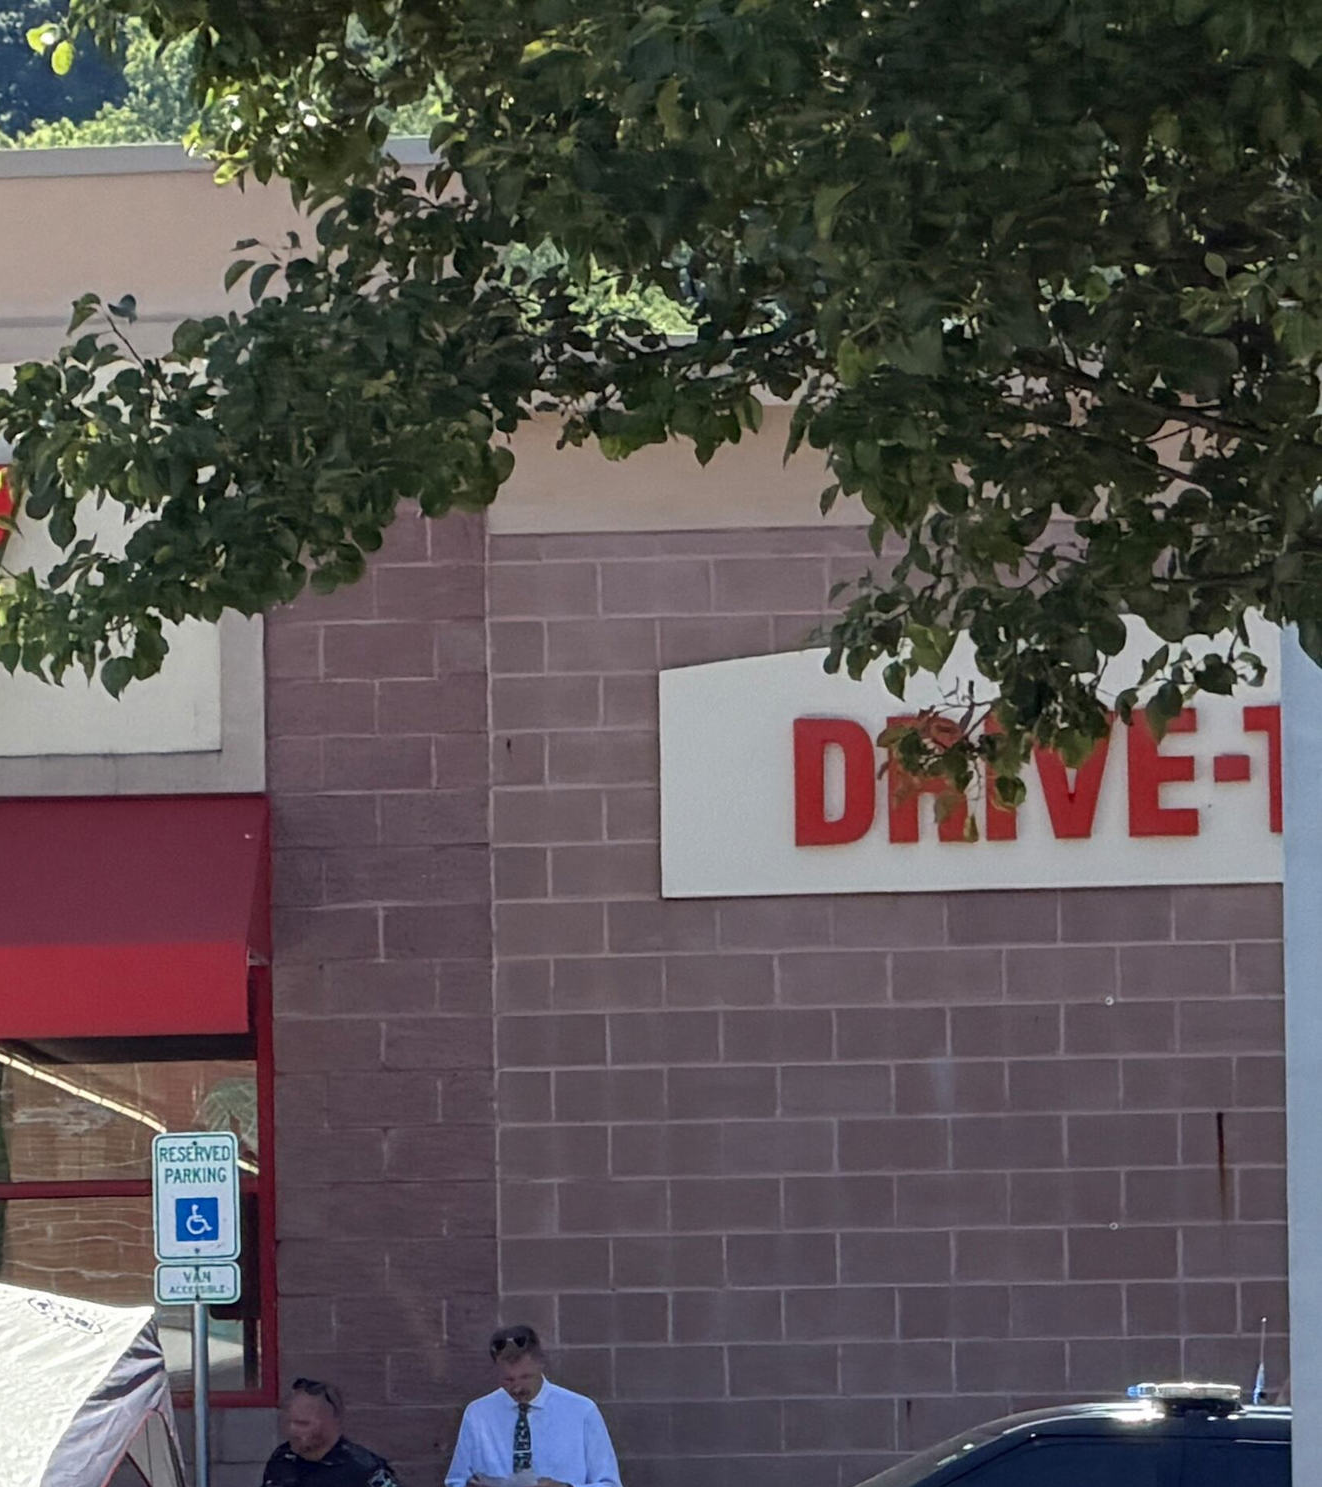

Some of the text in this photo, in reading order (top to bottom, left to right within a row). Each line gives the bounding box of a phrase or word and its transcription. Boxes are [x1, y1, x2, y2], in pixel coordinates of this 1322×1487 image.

[159, 1145, 231, 1162] RESERVED
[165, 1166, 227, 1184] PARKING
[183, 1271, 211, 1283] VAN
